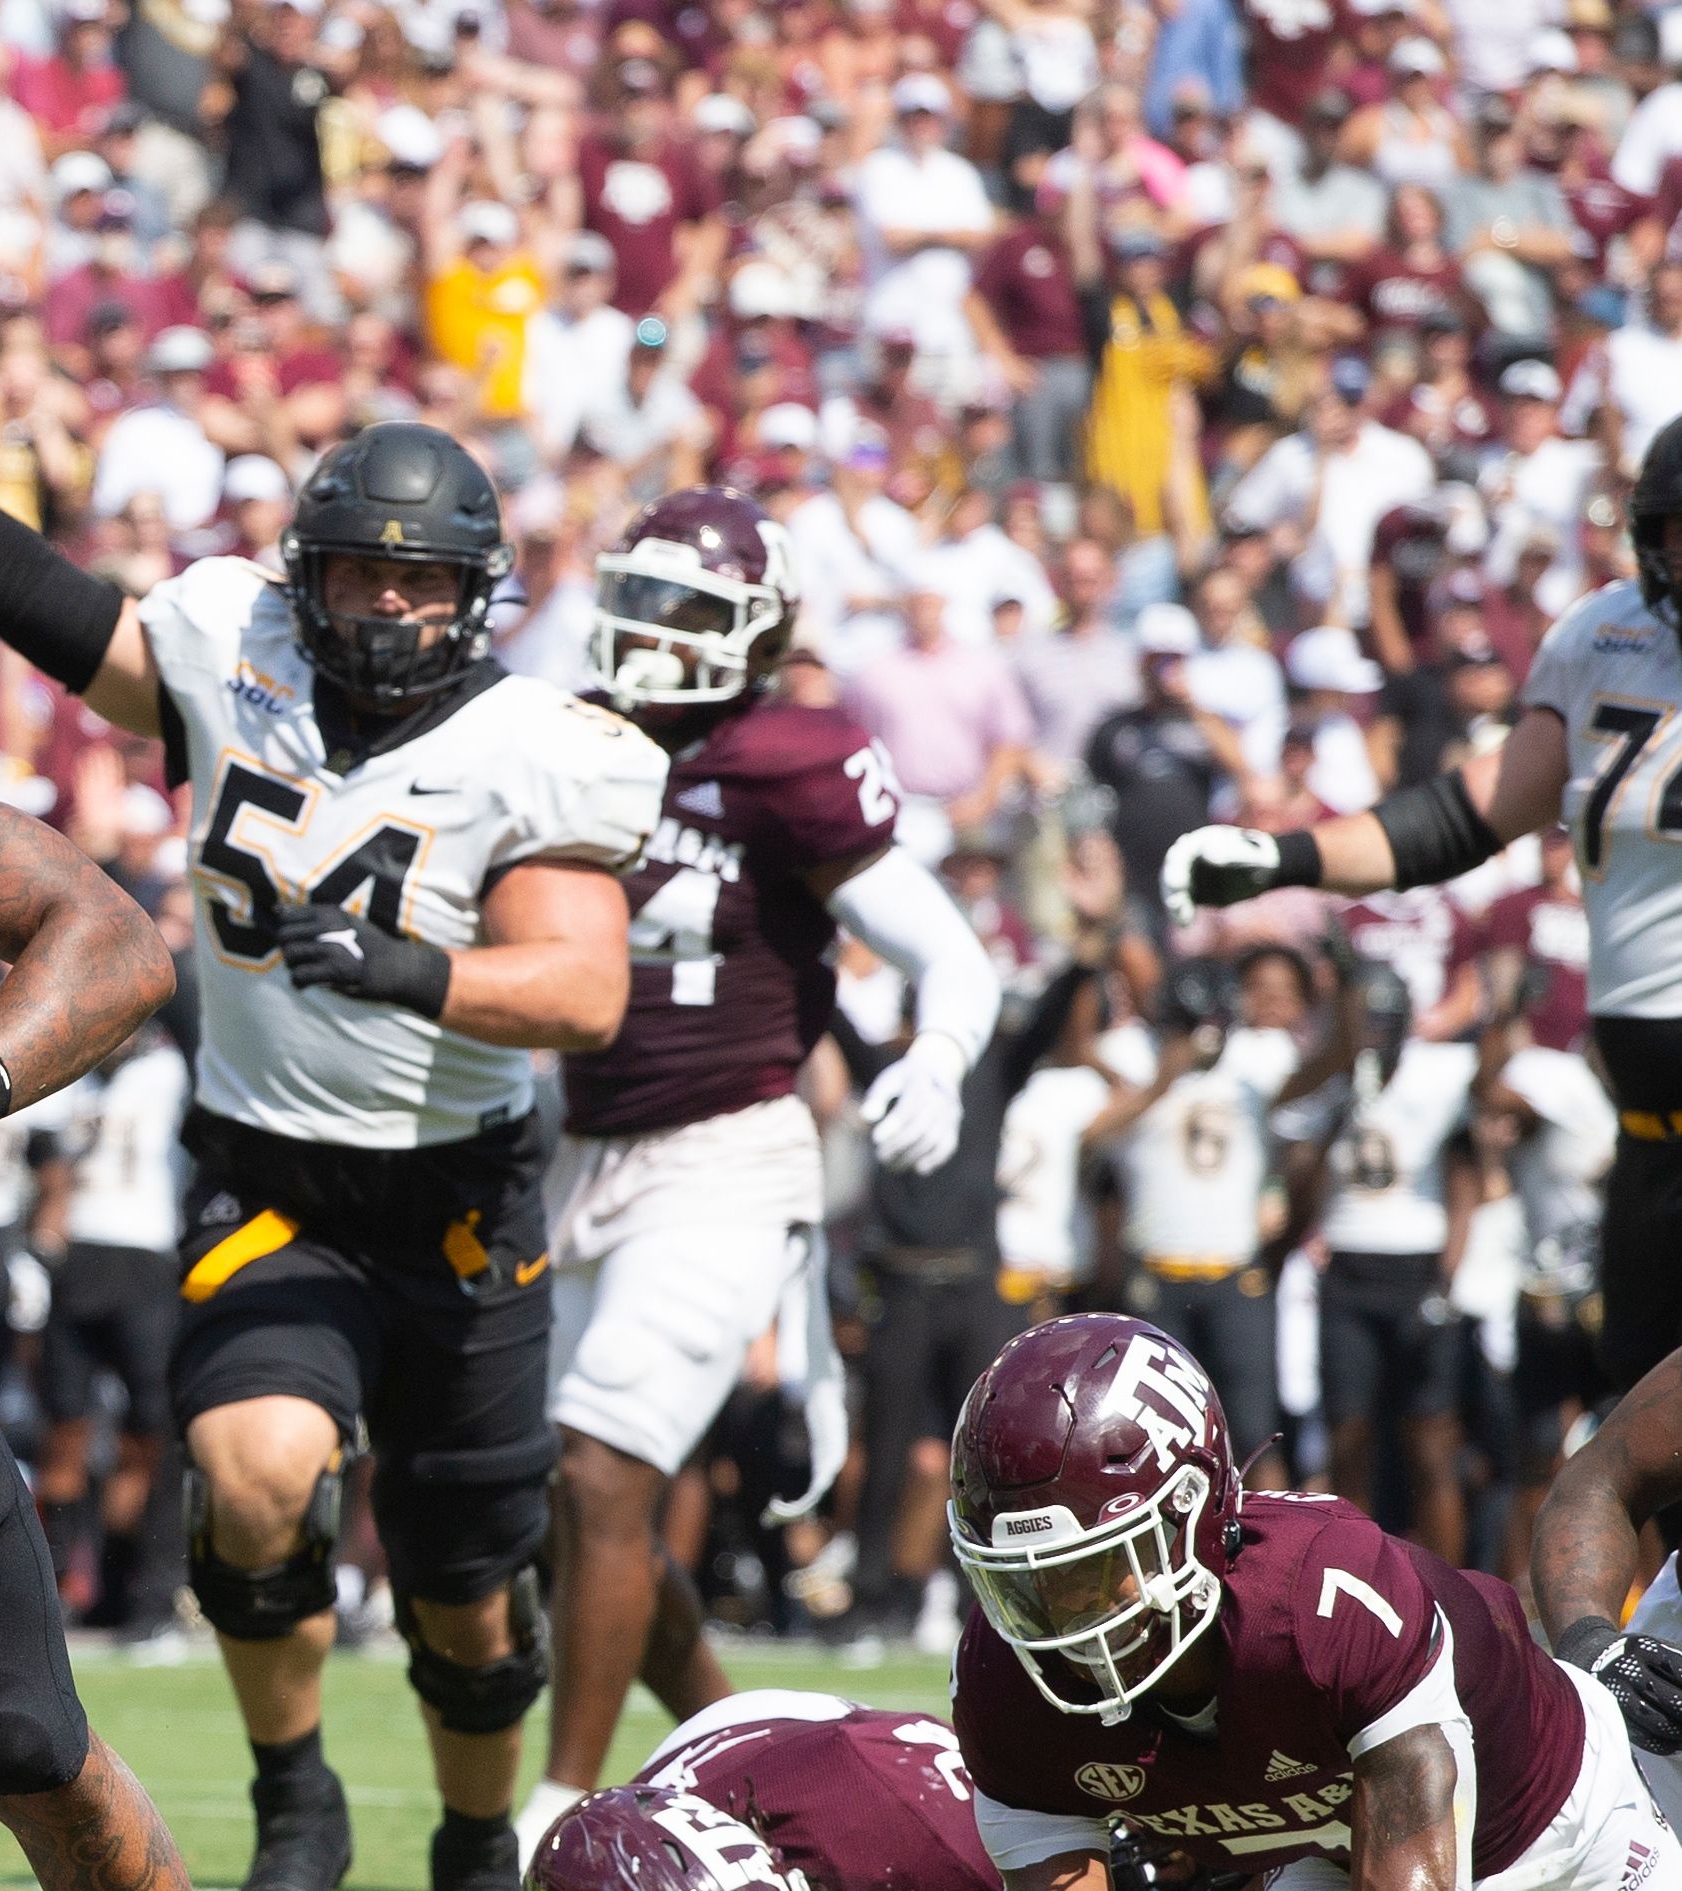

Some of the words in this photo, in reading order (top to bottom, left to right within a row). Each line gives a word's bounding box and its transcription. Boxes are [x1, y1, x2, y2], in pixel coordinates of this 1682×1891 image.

[190, 746, 437, 974] 54
[1005, 1515, 1053, 1536] AGGIES
[1317, 1567, 1404, 1639] 7
[1077, 1766, 1142, 1799] SEC
[1263, 1763, 1319, 1783] adidas
